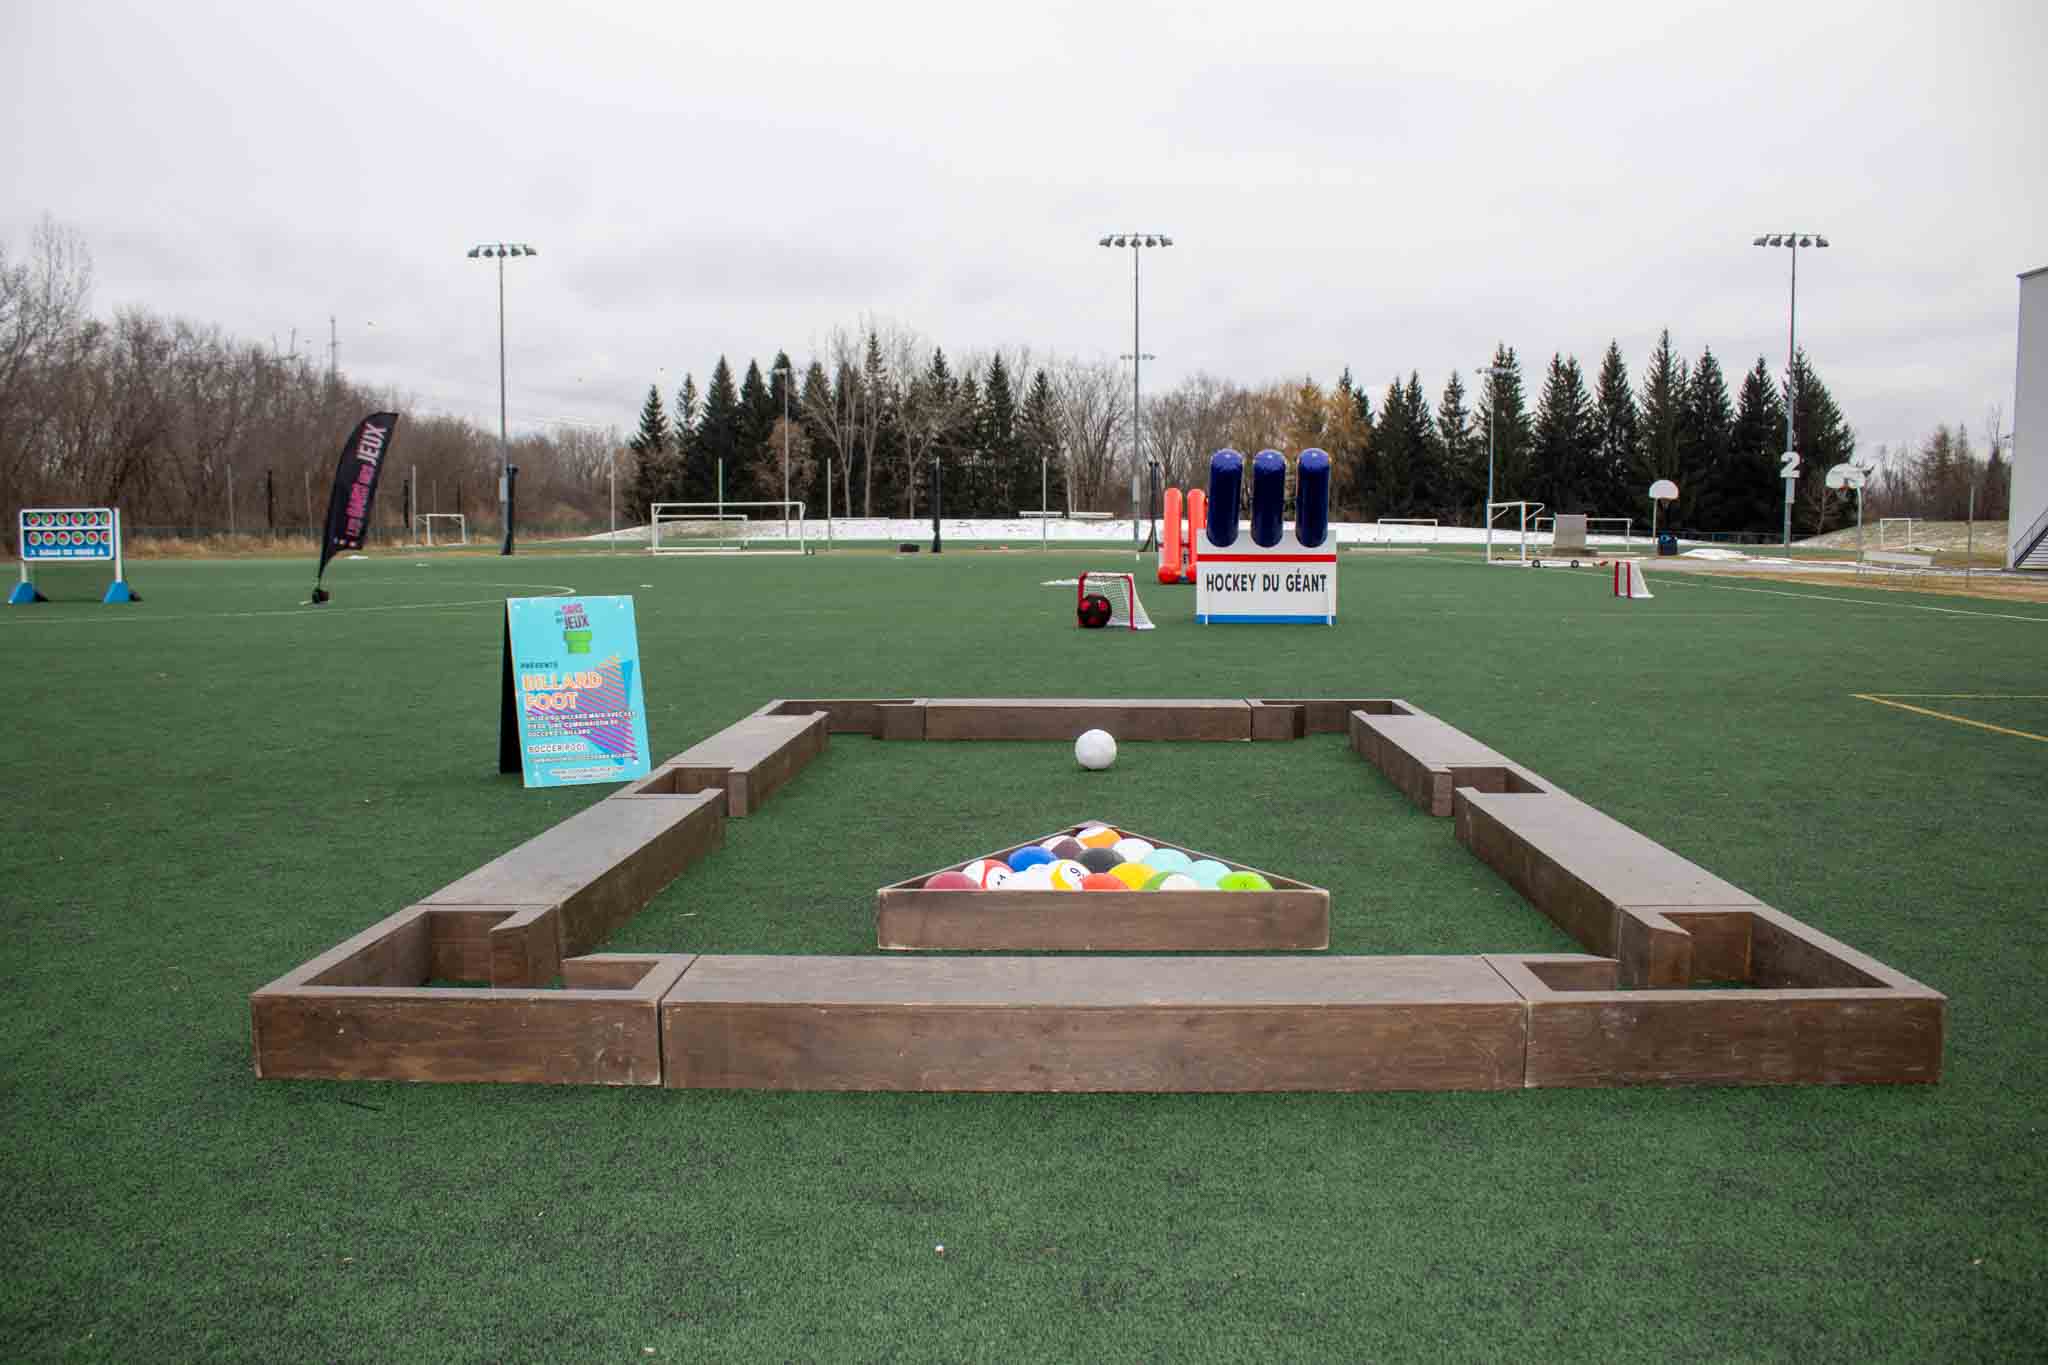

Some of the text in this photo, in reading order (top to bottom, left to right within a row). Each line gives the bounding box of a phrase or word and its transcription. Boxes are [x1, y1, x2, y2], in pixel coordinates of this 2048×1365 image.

[356, 422, 388, 467] JEUX
[1780, 451, 1800, 478] 2
[1206, 568, 1327, 592] HOCKEY DU GÉANT
[522, 672, 602, 690] BILLARD
[526, 691, 578, 710] FOOT
